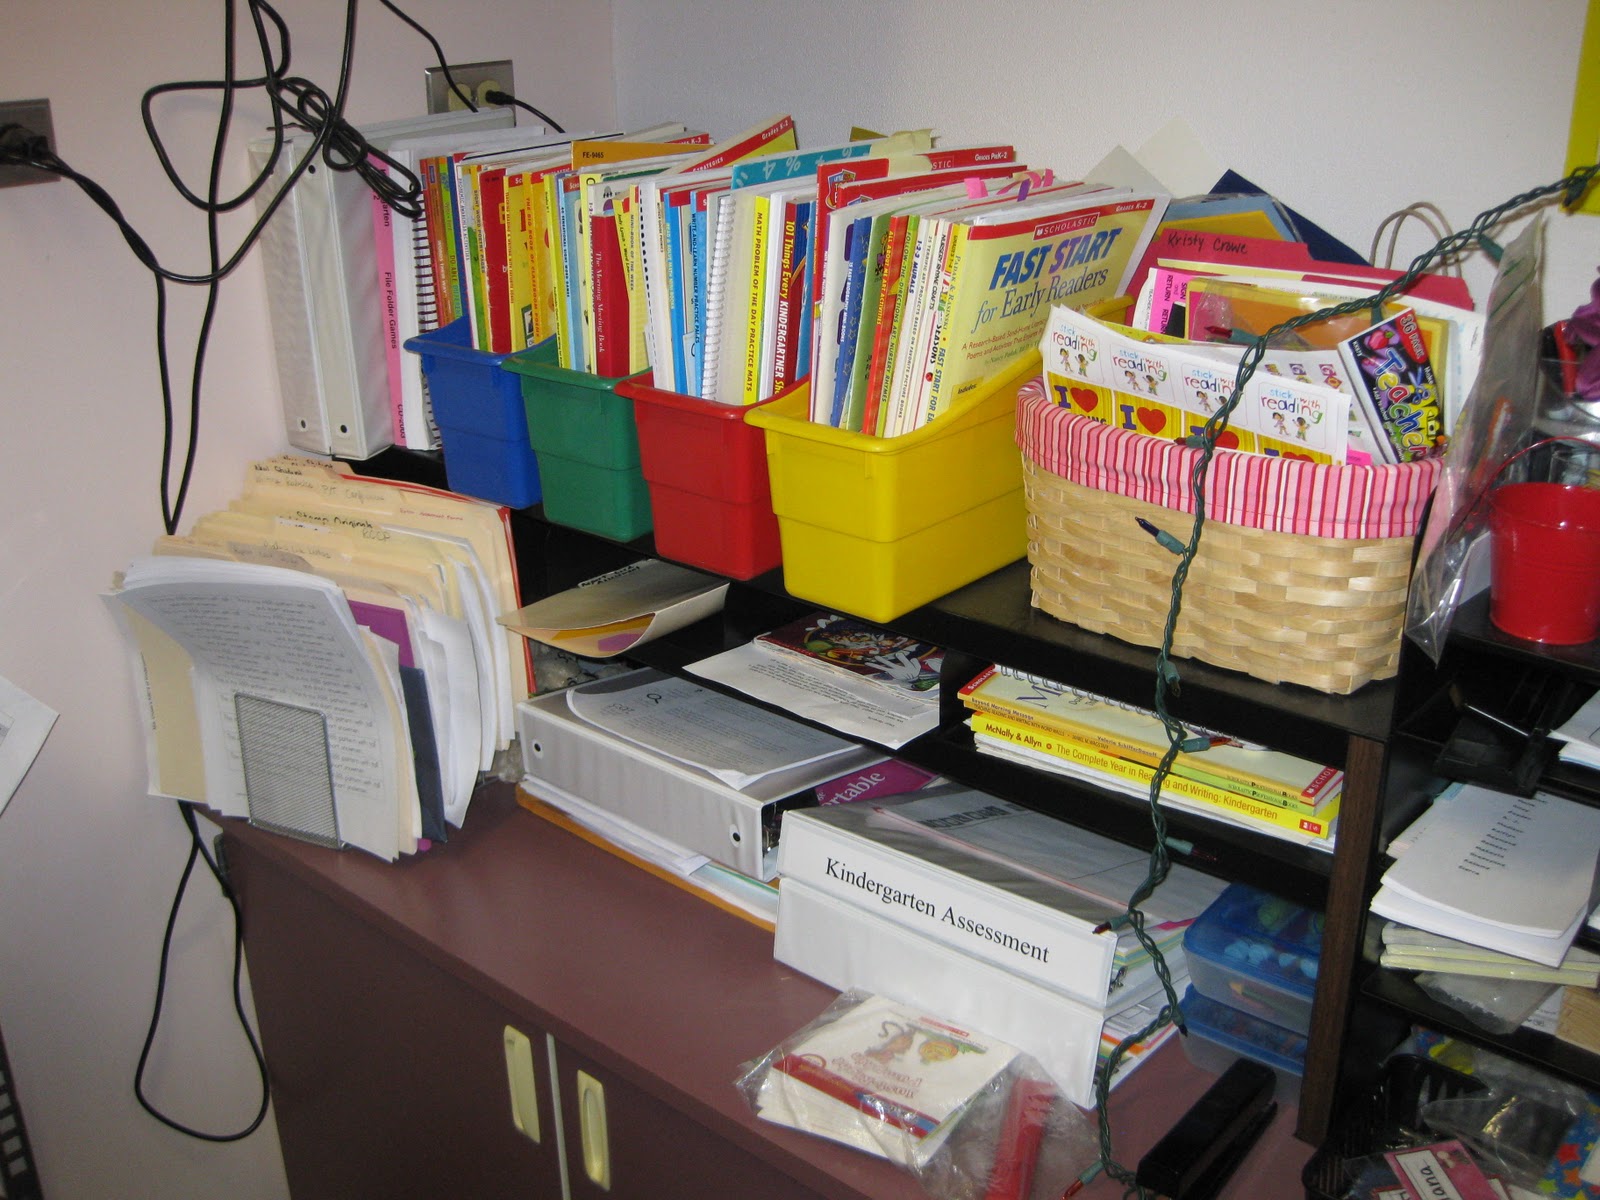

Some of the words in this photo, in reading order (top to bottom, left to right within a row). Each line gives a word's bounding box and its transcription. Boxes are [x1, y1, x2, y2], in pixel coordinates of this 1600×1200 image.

[761, 126, 779, 140] Grades
[779, 120, 789, 131] K-2
[785, 220, 795, 236] 101
[1043, 216, 1097, 235] SCHOLASTIC
[781, 238, 794, 270] Things
[937, 234, 947, 263] NURSERY
[1168, 231, 1204, 252] Kristy
[1213, 237, 1248, 254] Crowe
[753, 238, 762, 277] PROBLEM
[923, 245, 931, 272] TERRIFIC
[951, 255, 961, 282] PADAK
[989, 244, 1053, 291] FAST
[1048, 228, 1123, 274] START
[595, 269, 603, 301] Morning
[752, 278, 759, 290] OF
[779, 270, 792, 299] Every
[883, 267, 889, 277] ME
[894, 231, 911, 323] FOLLOW-THE-DIRECTIONS
[909, 261, 919, 294] MURALS
[933, 263, 942, 286] RHYME
[915, 285, 924, 315] PROJECTS
[929, 285, 938, 311] CRAFTS
[971, 300, 998, 334] for
[1000, 281, 1046, 319] Early
[1047, 267, 1109, 303] Readers
[1164, 274, 1174, 302] RETURN
[1179, 282, 1188, 300] SIGN
[386, 289, 396, 318] Folder
[877, 292, 885, 325] ACTIVITIES
[942, 294, 954, 331] RASINSKI
[389, 319, 398, 349] Games
[1061, 324, 1075, 336] stick
[1159, 308, 1169, 334] RETURN
[1398, 313, 1419, 335] 36
[747, 327, 756, 368] PRACTICE
[773, 300, 790, 378] KINDERGARTNER
[910, 336, 915, 345] ON
[930, 324, 942, 365] SEASONS
[1053, 331, 1097, 362] reading
[1408, 332, 1426, 360] PACK
[886, 342, 895, 373] NURSERY
[906, 346, 914, 373] FAVORITE
[936, 347, 946, 367] FAST
[1119, 349, 1138, 359] stick
[931, 368, 943, 394] START
[1112, 356, 1167, 382] reading
[1191, 369, 1213, 379] stick
[1220, 377, 1236, 388] wit
[882, 374, 890, 403] RHYMES
[901, 374, 909, 398] PICTURE
[1184, 375, 1232, 394] readin
[1269, 388, 1292, 399] stick
[929, 395, 938, 412] FOR
[1261, 395, 1323, 424] reading
[1376, 347, 1428, 456] Teacher
[1120, 404, 1137, 430] I
[971, 698, 990, 707] Beyond
[990, 703, 1012, 714] Morning
[985, 724, 1015, 739] McNally
[1024, 735, 1044, 747] Allyn
[1056, 744, 1073, 755] The
[1072, 749, 1109, 767] Complete
[1108, 760, 1128, 771] Year
[1128, 766, 1139, 775] in
[1137, 769, 1172, 787] Reang
[1173, 780, 1191, 791] and
[1189, 785, 1223, 802] Writing:
[1223, 795, 1279, 819] Kindergarten
[826, 856, 936, 919] Kindergarten
[941, 906, 1051, 964] Assessment
